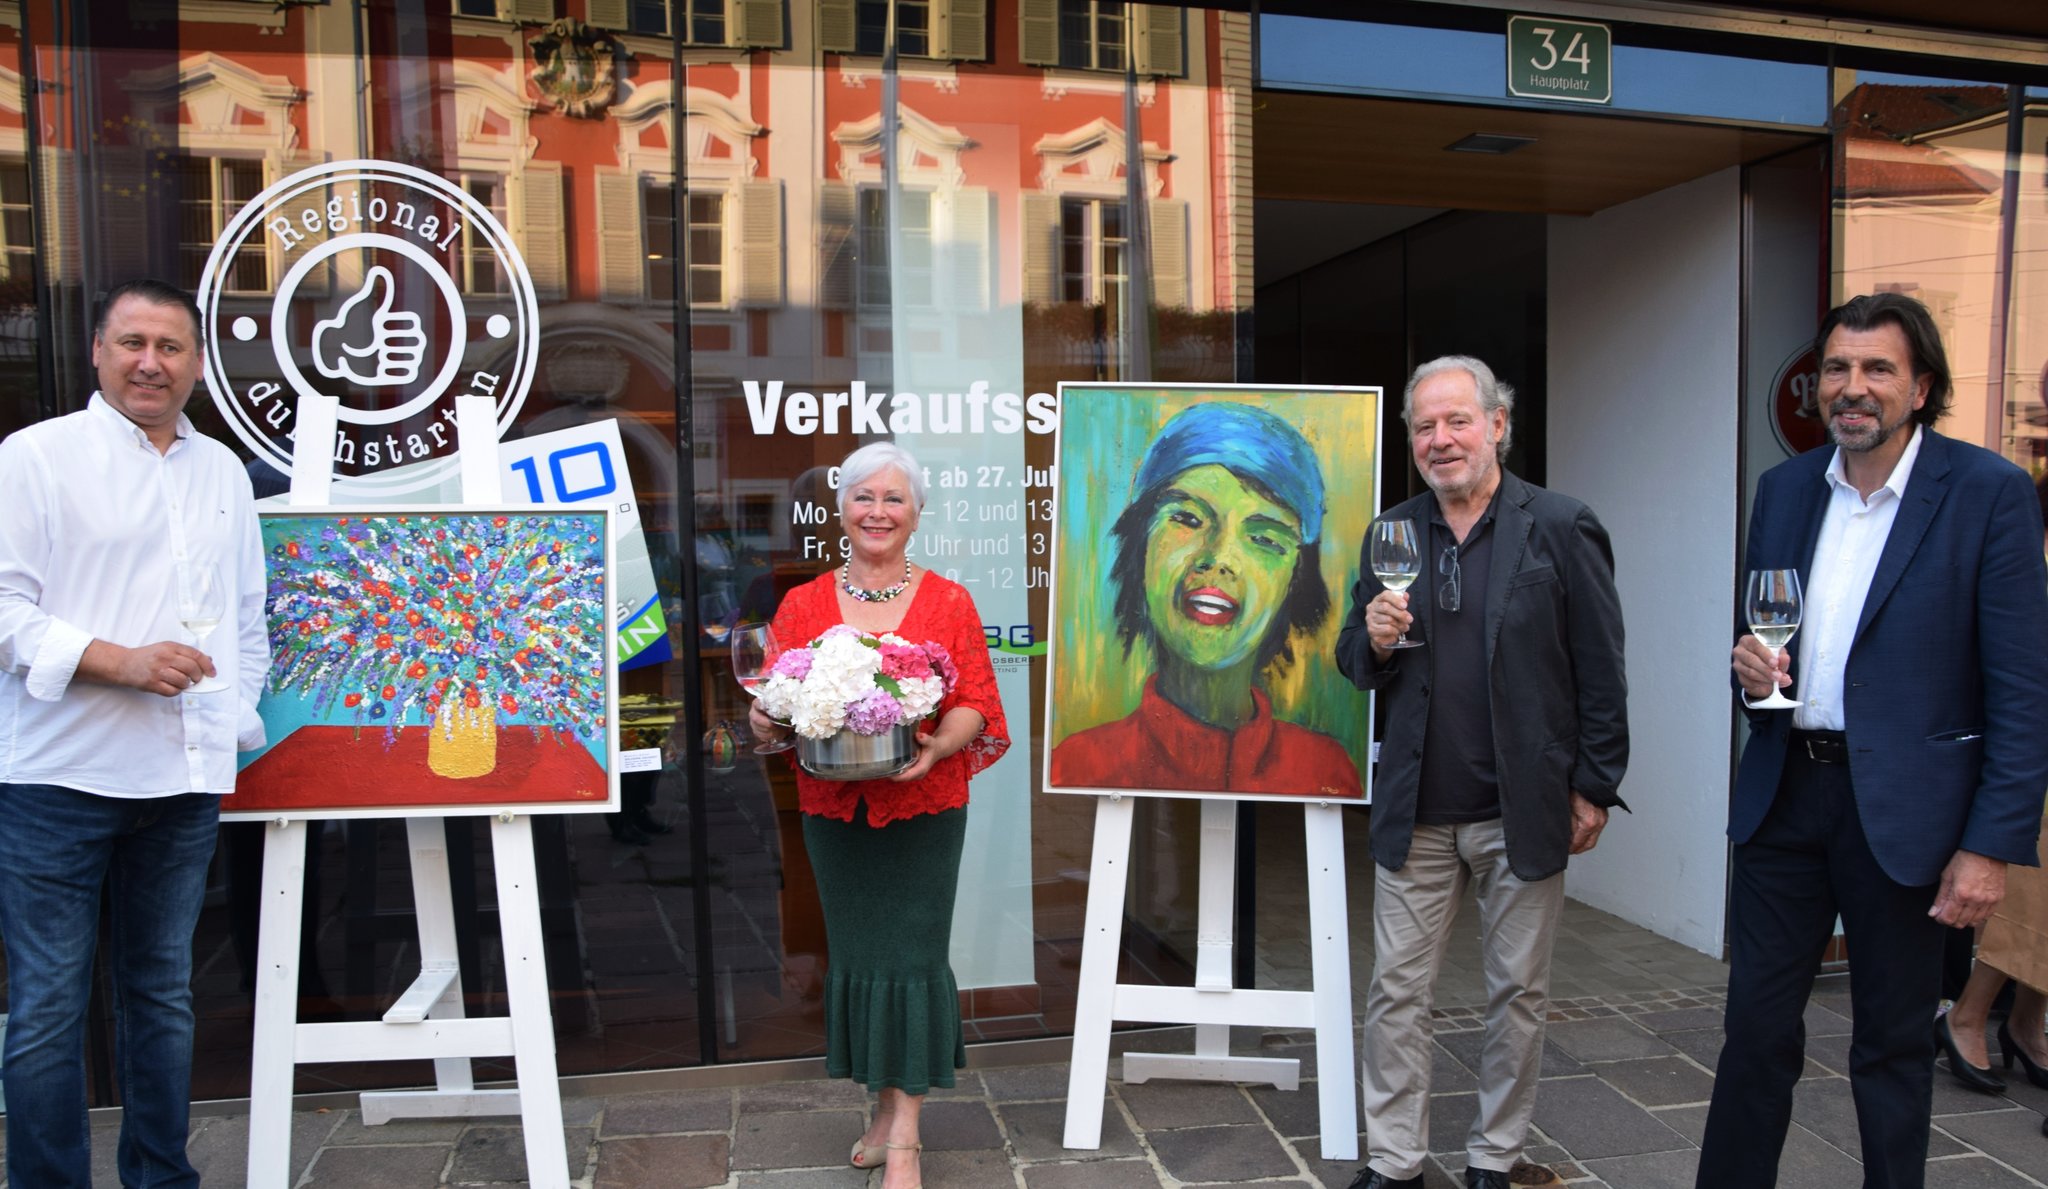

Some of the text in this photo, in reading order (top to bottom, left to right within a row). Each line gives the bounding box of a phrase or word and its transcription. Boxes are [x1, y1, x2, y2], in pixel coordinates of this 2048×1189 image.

[1530, 27, 1591, 74] 34
[1530, 74, 1590, 91] Hauptplatz
[267, 190, 462, 251] Regional
[247, 369, 500, 466] duhstartn
[510, 441, 617, 503] 10
[940, 465, 969, 488] ab
[976, 465, 1012, 488] 27.
[792, 501, 827, 525] Mo
[943, 501, 969, 522] 12
[979, 499, 1018, 521] und
[803, 536, 831, 561] Fr,
[925, 535, 962, 557] Uhr
[970, 533, 1009, 554] und
[1020, 533, 1046, 555] 13
[987, 569, 1014, 588] 12
